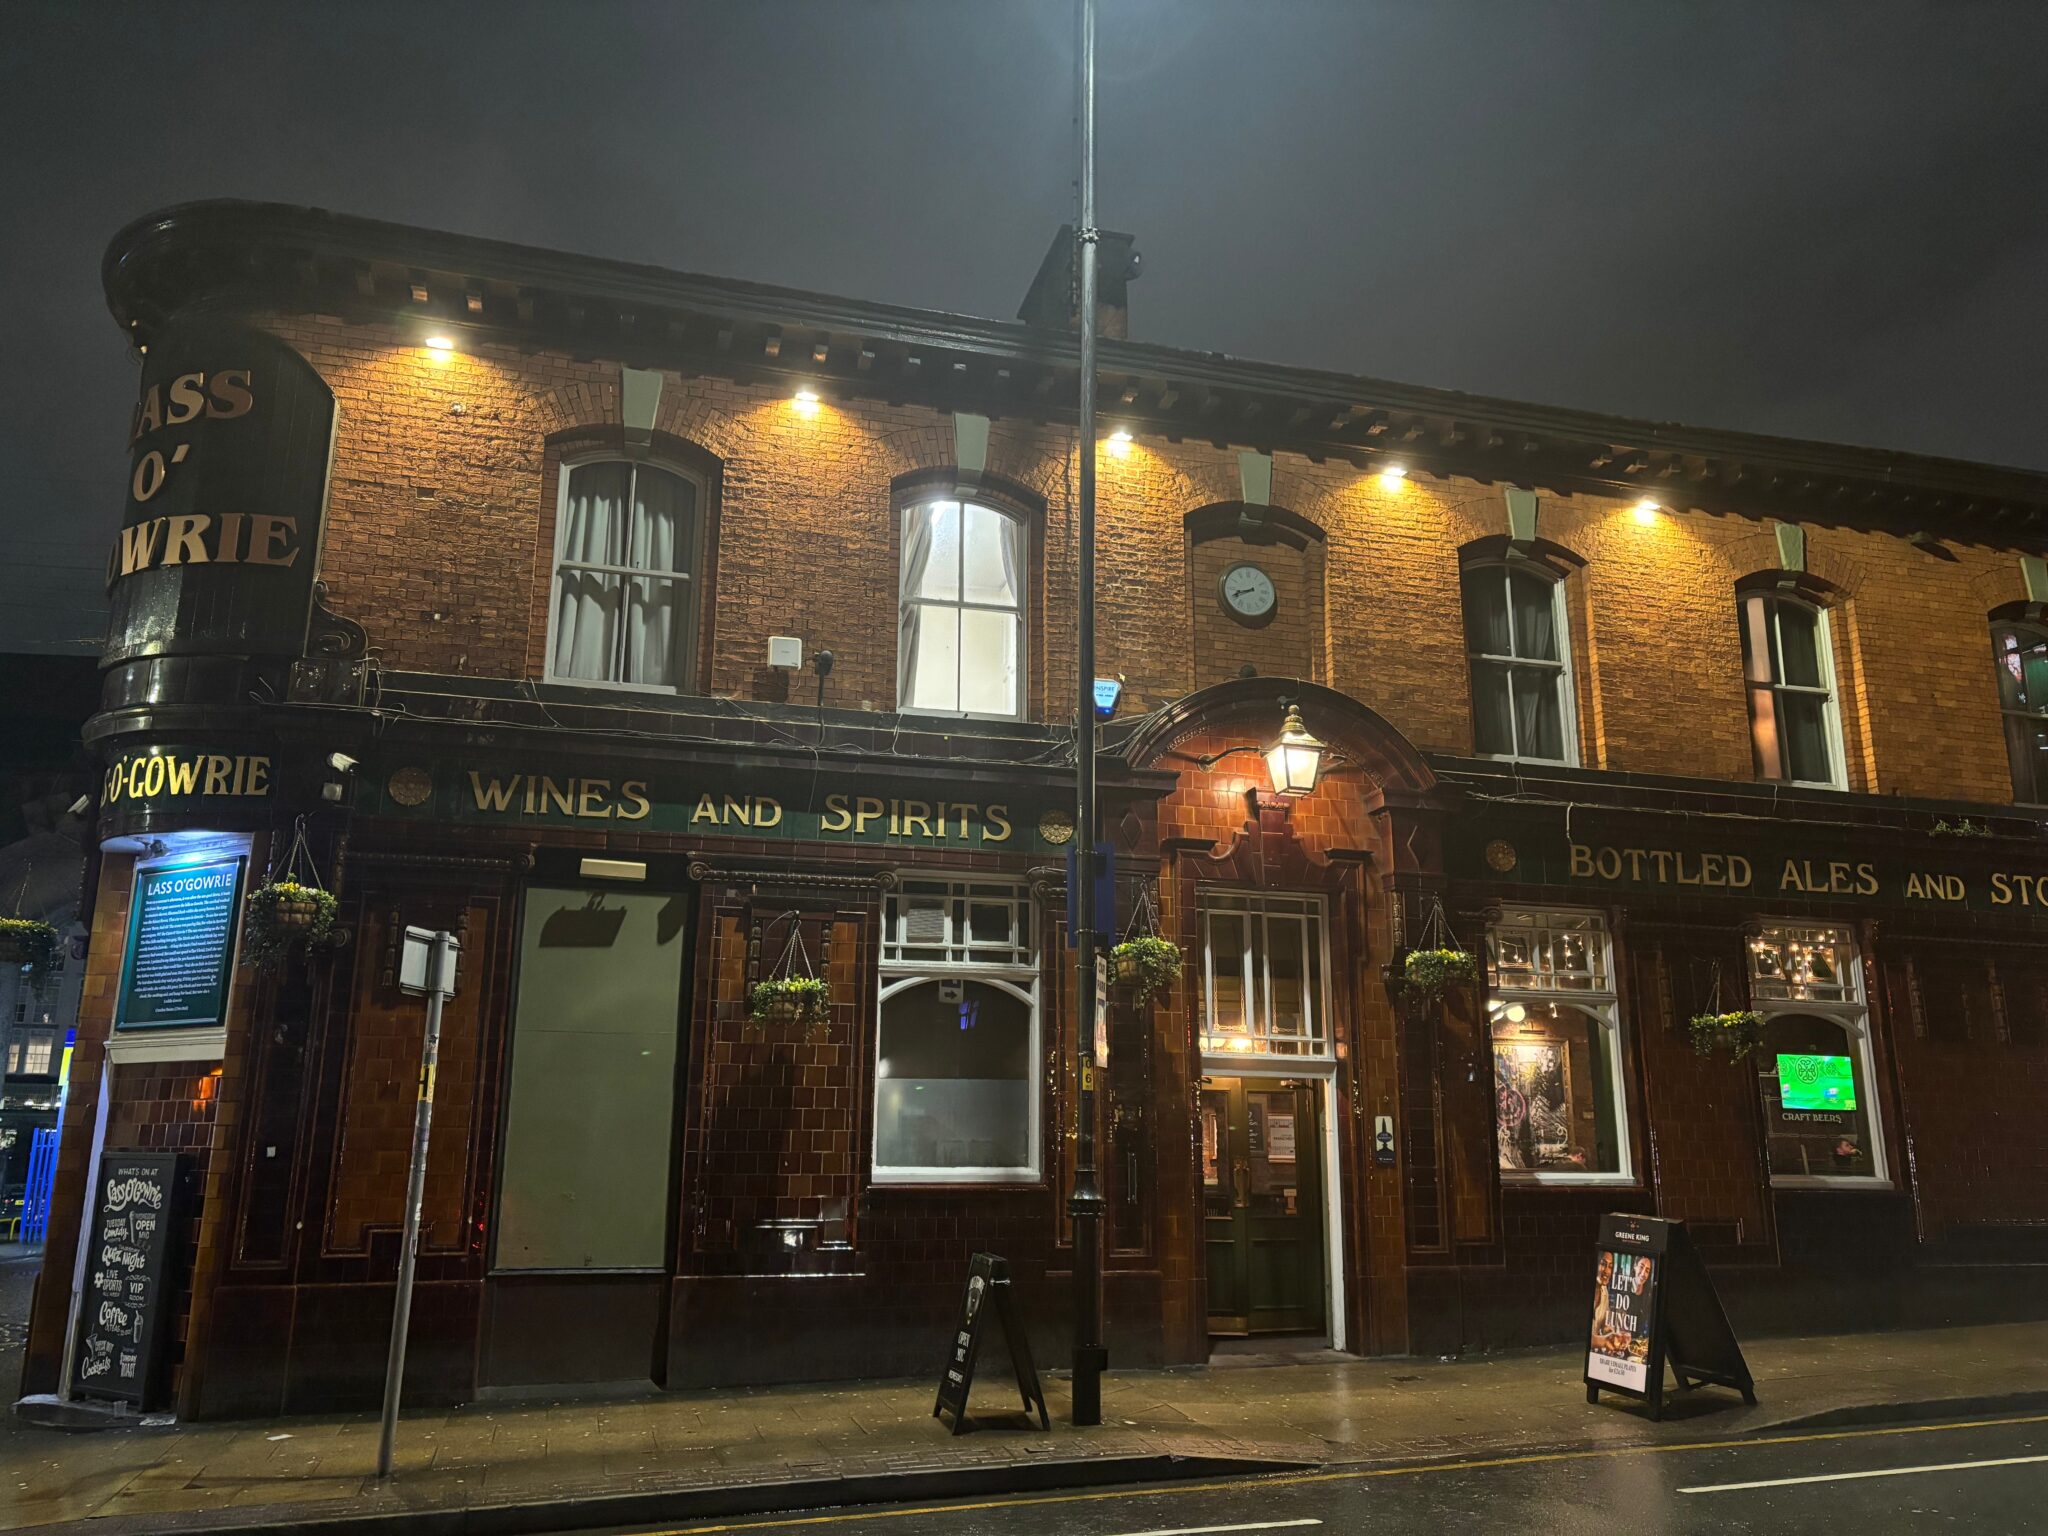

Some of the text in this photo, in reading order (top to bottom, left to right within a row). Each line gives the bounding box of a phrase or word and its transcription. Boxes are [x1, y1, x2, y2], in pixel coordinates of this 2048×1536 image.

[130, 370, 254, 446] ASS
[132, 443, 191, 502] O'
[467, 770, 1012, 842] WINES AND SPIRITS
[1569, 844, 1753, 888] BOTTLED
[1780, 859, 1879, 896] ALES
[1906, 872, 1965, 901] AND
[147, 873, 232, 896] LASS O'GOWRIE
[1782, 1112, 1842, 1124] CRAFT BEERS
[118, 1168, 159, 1176] WHAT'S ON AT
[135, 1220, 156, 1231] OPEN
[1614, 1231, 1635, 1240] GREENE
[1635, 1233, 1650, 1242] KING
[121, 1252, 146, 1273] Night
[106, 1269, 119, 1279] LIVE
[1611, 1273, 1638, 1294] LET'S
[102, 1278, 123, 1293] SPORTS
[129, 1282, 144, 1294] VIP
[1615, 1293, 1630, 1311] DO
[98, 1300, 128, 1326] Coffee
[1604, 1310, 1638, 1332] LUNCH
